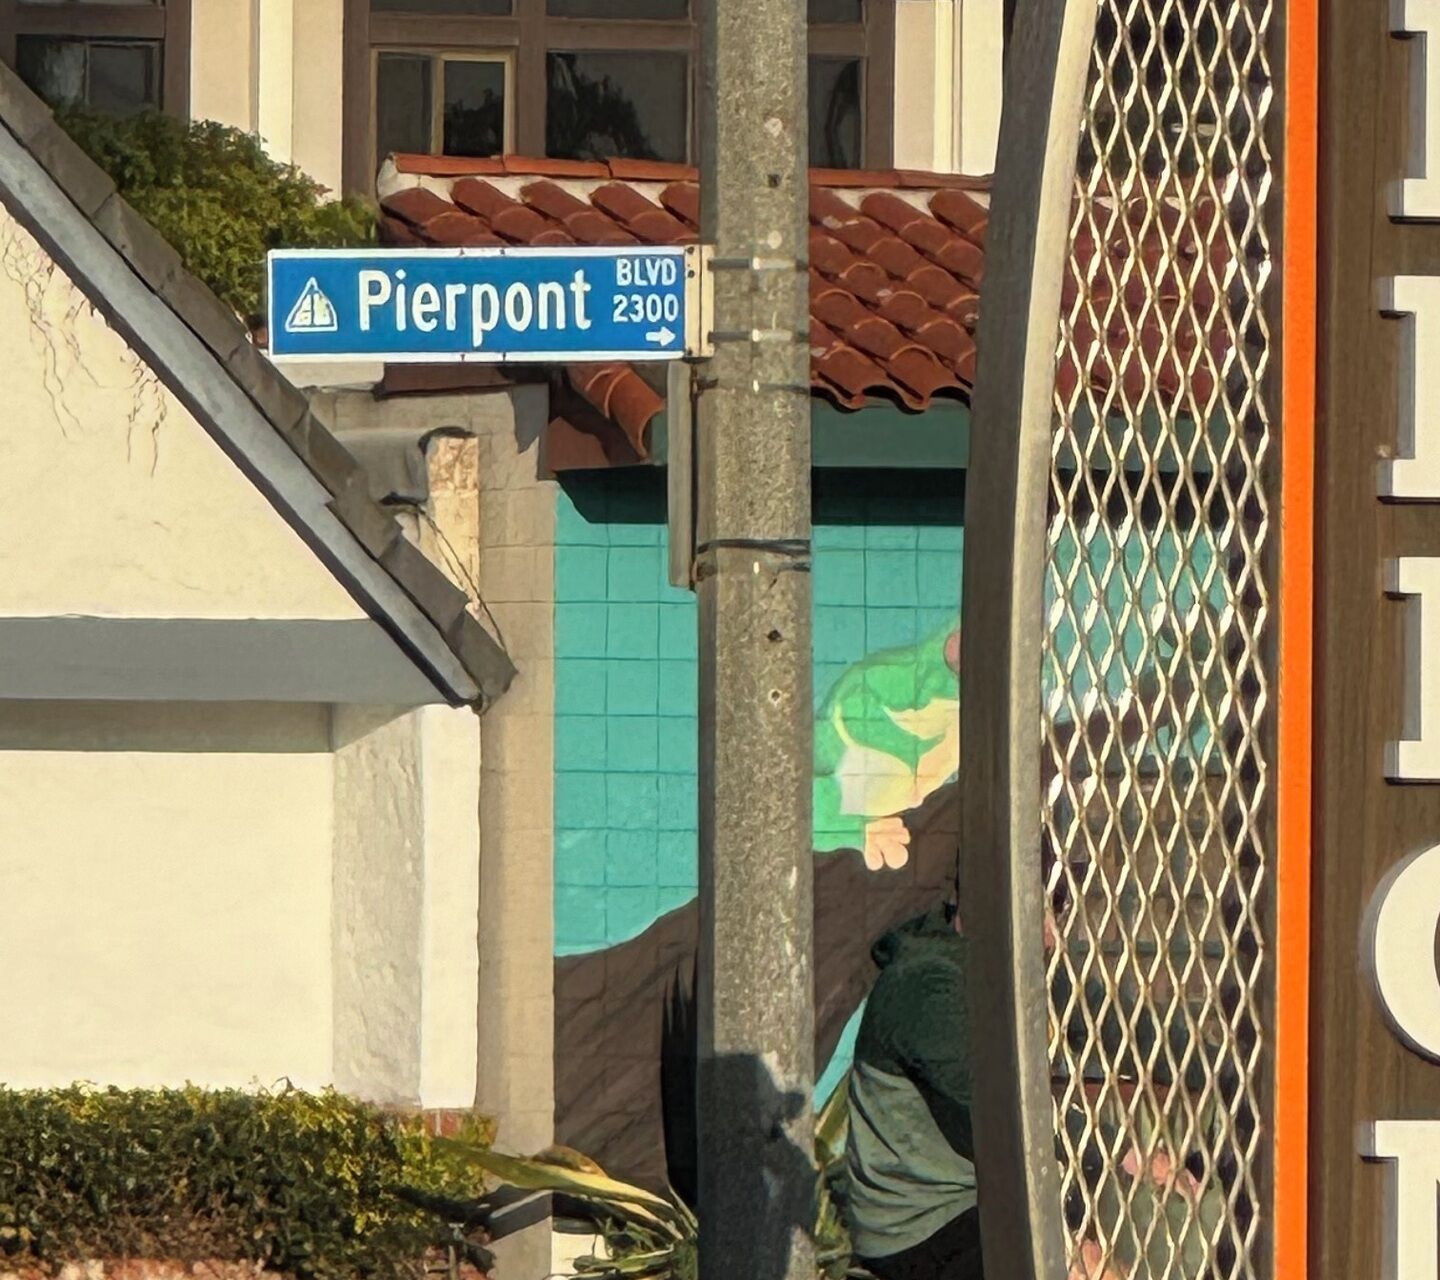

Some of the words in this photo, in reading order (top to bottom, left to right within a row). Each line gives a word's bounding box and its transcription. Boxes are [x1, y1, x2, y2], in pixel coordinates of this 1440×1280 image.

[616, 258, 676, 286] BLVD
[357, 268, 592, 348] Pierpont
[612, 294, 679, 322] 2300
